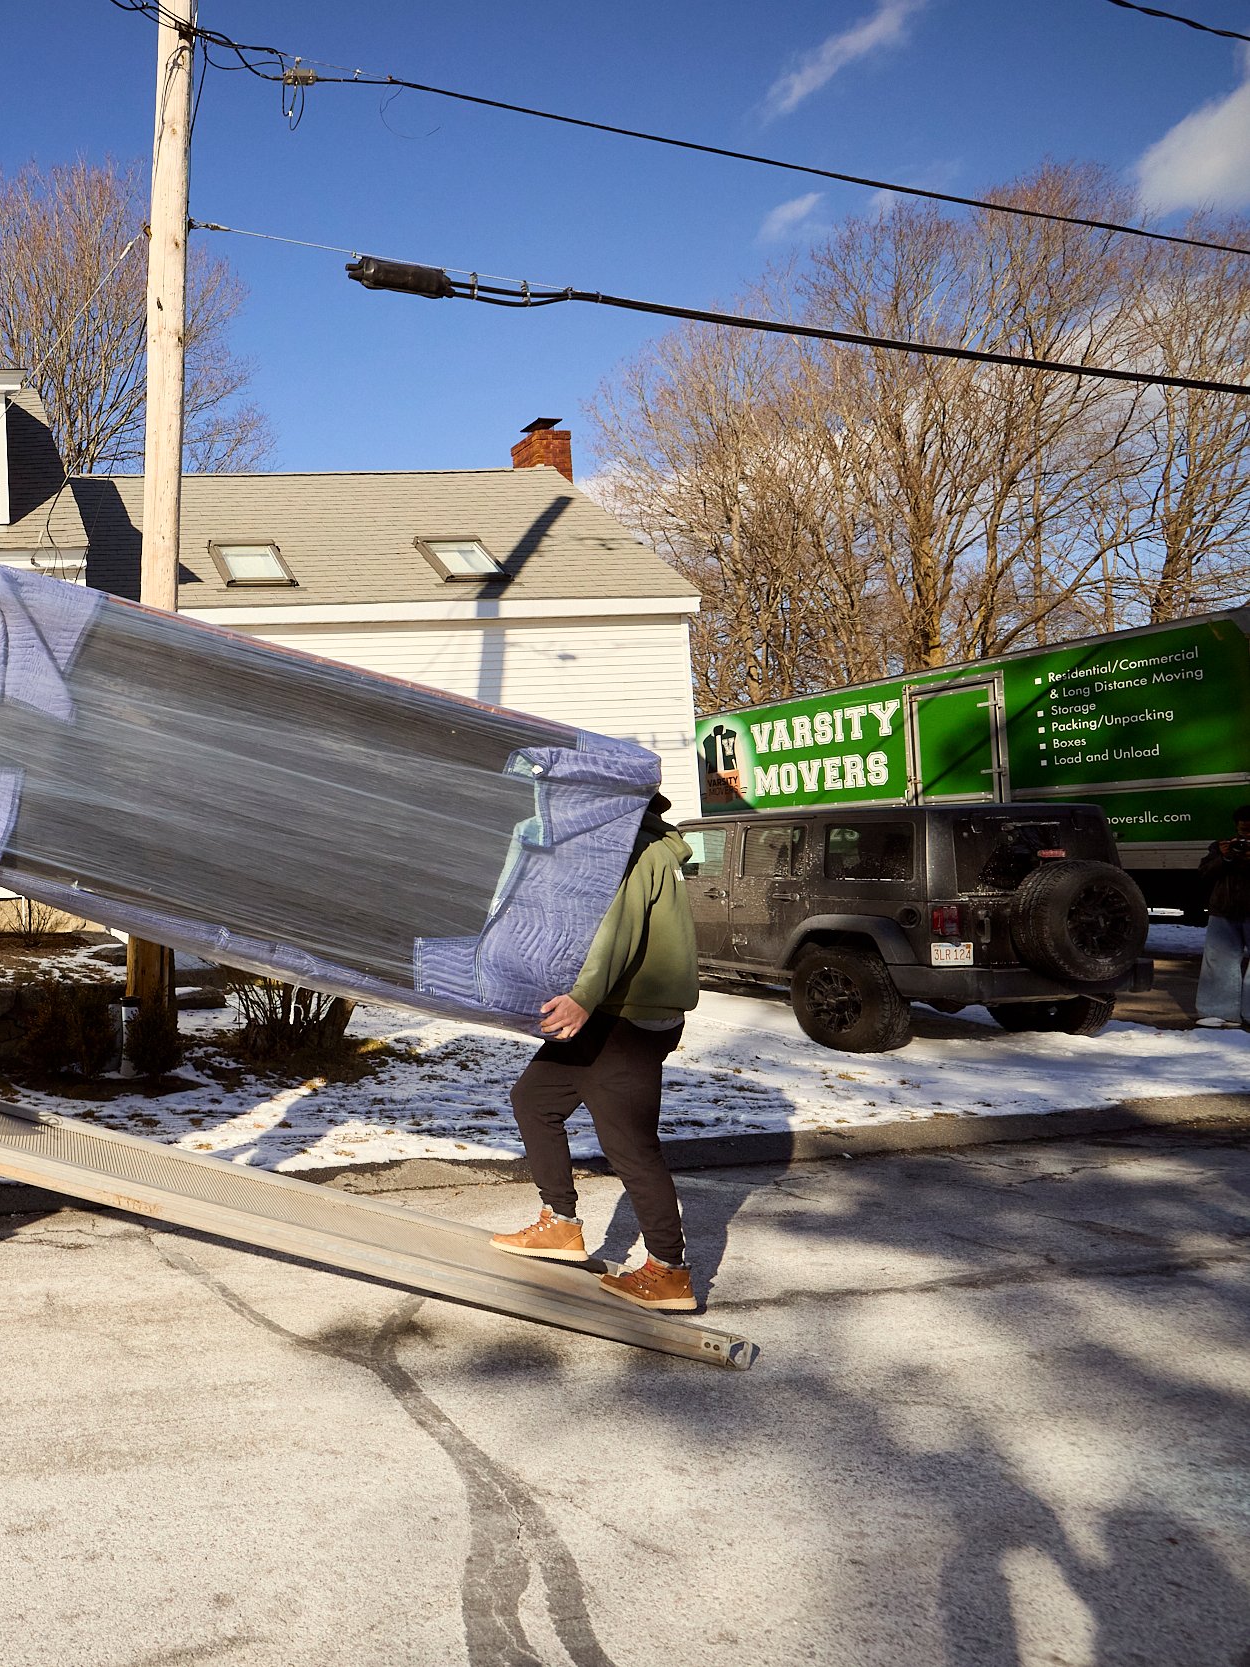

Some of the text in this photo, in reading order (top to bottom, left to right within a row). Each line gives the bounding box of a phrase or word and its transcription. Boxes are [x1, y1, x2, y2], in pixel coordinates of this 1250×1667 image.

[1048, 645, 1199, 683] Residential/Commercial
[1050, 668, 1204, 699] & Long Distance Moving
[1051, 702, 1096, 716] Storage
[1051, 709, 1174, 732] Packing/Unpacking
[750, 699, 900, 754] VARSITY
[1052, 738, 1087, 749] Boxes
[1054, 744, 1160, 766] Load and Unload
[707, 775, 739, 788] VARSITY
[753, 751, 889, 797] MOVERS
